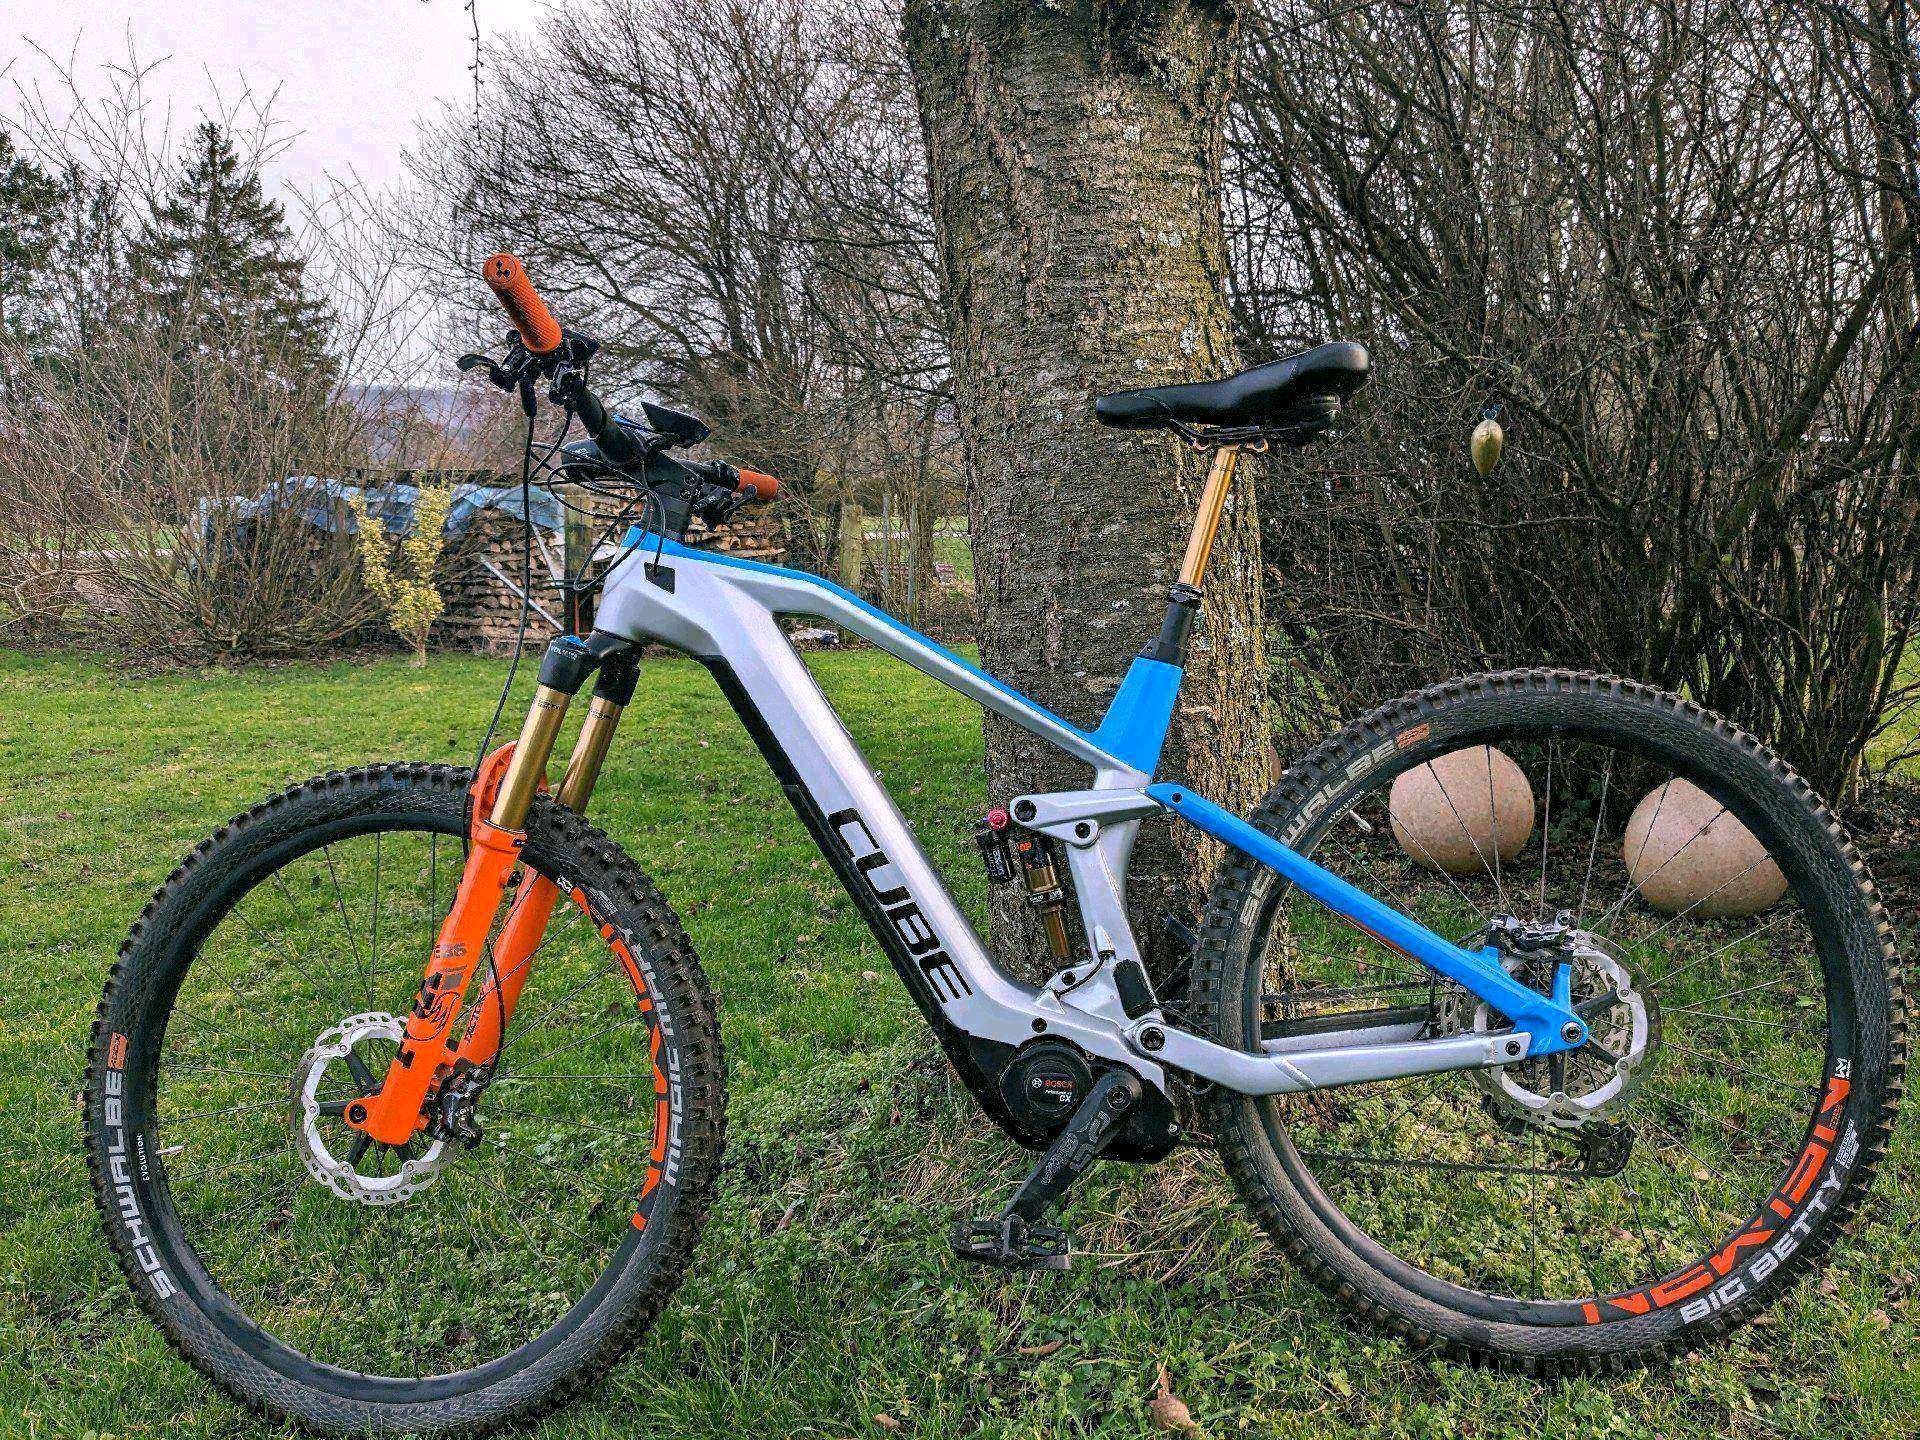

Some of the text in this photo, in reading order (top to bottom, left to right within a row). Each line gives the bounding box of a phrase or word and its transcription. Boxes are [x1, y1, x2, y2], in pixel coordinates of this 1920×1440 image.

[1239, 739, 1396, 929] SCWALBE
[1328, 789, 1366, 824] EVOLUTION
[827, 807, 973, 1004] CUBE
[619, 927, 684, 1187] MAGIC MARY
[1044, 1080, 1074, 1090] BOSCH
[1059, 1094, 1071, 1103] CX
[104, 1070, 178, 1300] SCHWALBE
[135, 1133, 150, 1182] EVOLUTION
[1680, 1166, 1842, 1325] BIG BETTY
